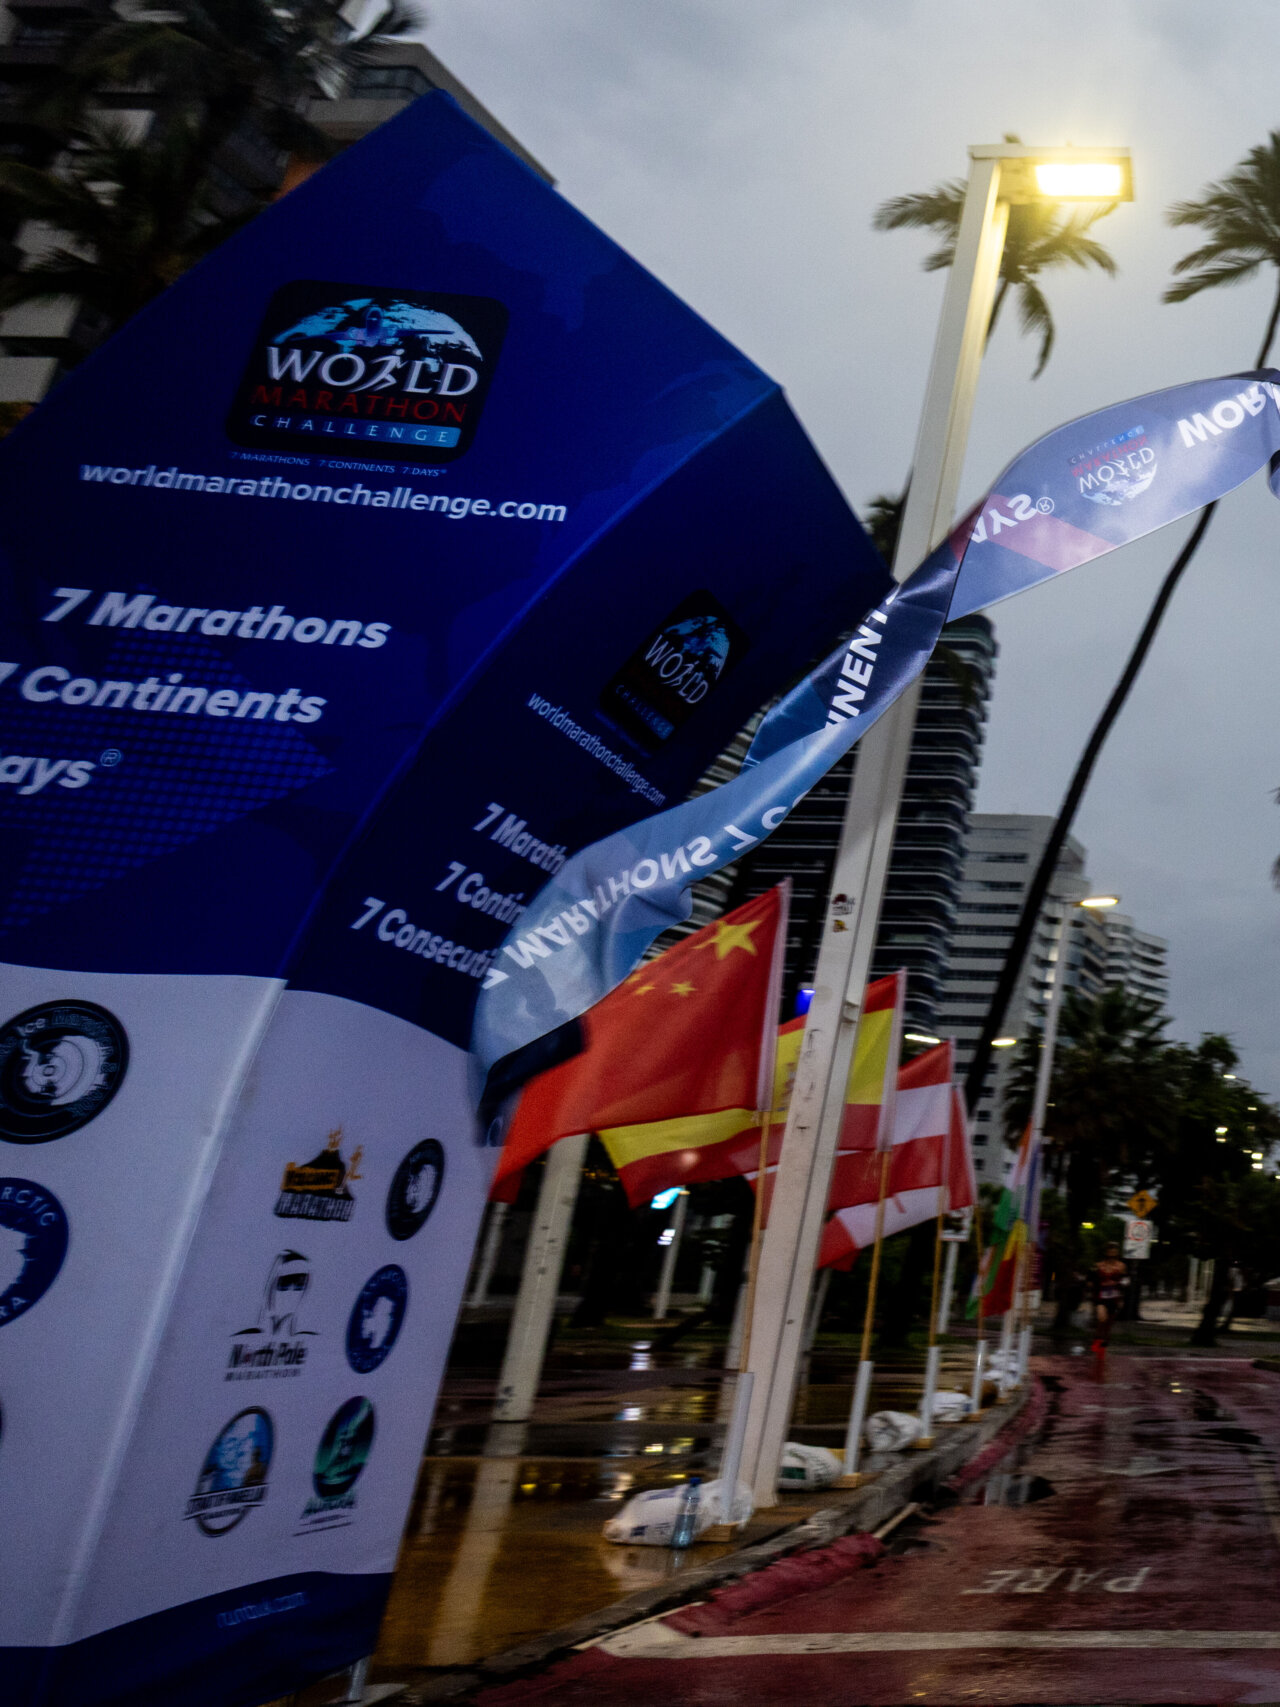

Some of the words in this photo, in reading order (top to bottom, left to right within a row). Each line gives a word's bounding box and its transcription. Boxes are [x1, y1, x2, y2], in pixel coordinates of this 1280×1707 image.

[252, 384, 468, 423] MARATHON
[253, 414, 451, 443] CHALLENGE
[240, 452, 311, 467] MARATHONS
[328, 459, 396, 474] CONTINENTS
[80, 464, 568, 524] worldmarathonchallenge.com
[42, 586, 93, 622] 7
[86, 591, 393, 650] Marathons
[20, 664, 328, 724] Continents
[527, 692, 667, 808] worldmarathonchallenge.com
[471, 801, 506, 832] 7
[489, 812, 569, 876] Marath
[433, 860, 468, 892] 7
[350, 896, 387, 931] 7
[376, 908, 500, 980] Consecuti
